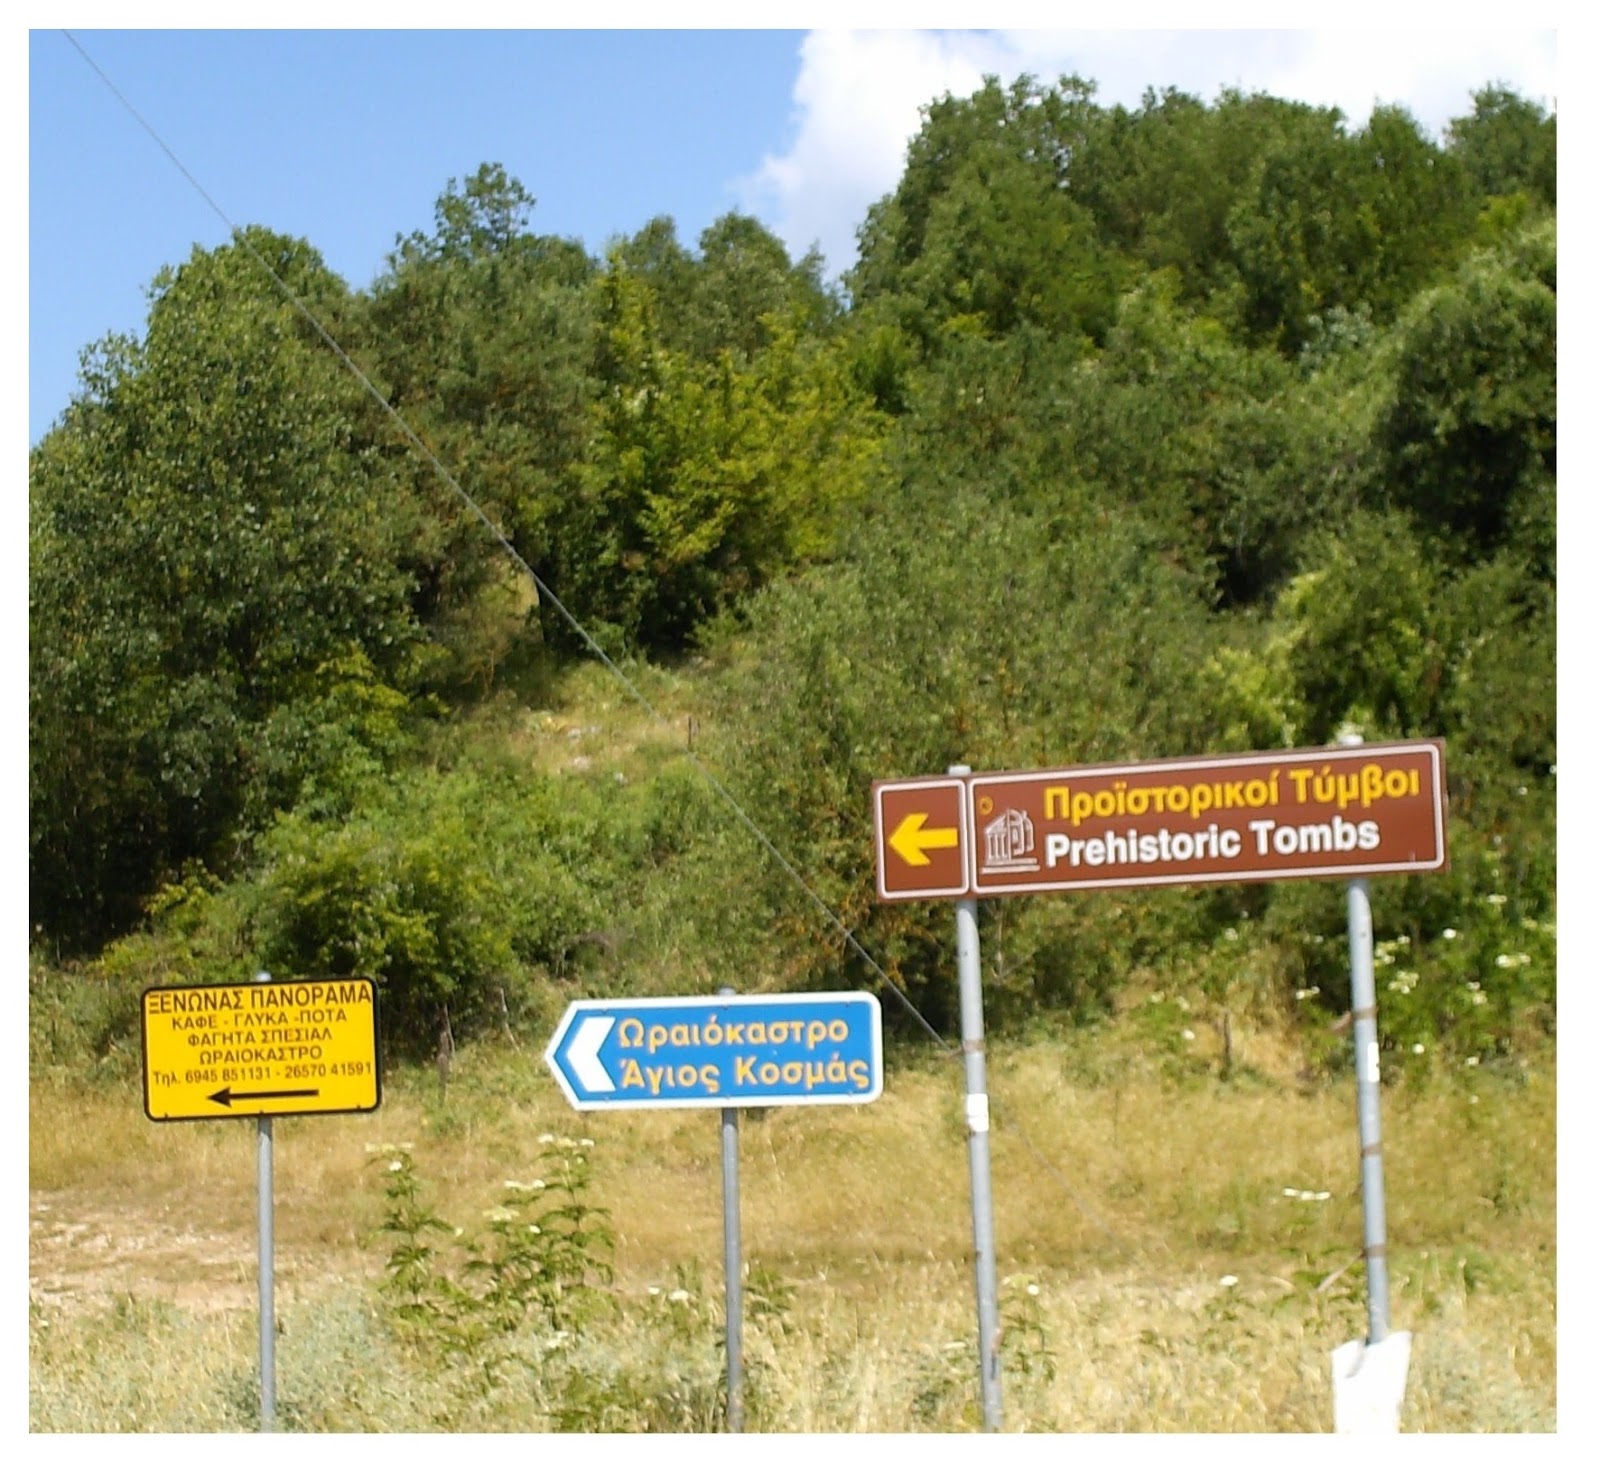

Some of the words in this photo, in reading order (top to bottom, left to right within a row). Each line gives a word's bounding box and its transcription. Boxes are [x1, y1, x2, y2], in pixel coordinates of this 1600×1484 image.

[1044, 768, 1281, 827] Προϊστορικοί
[1287, 763, 1420, 810] Τύμβοι
[1045, 823, 1242, 868] Prehistoric
[1248, 815, 1381, 855] Tombs
[149, 988, 244, 1014] ΞΕΝΩΝΑΣ
[251, 983, 371, 1009] ΠΑΝΟΡΑΜΑ
[172, 1014, 217, 1030] ΚΑΦΕ
[234, 1011, 289, 1028] ΓΛΥΚΑ
[618, 1014, 849, 1054] Ωραιόκαστρο
[188, 1030, 256, 1047] ΦΑΓΗΤΑ
[261, 1027, 333, 1044] ΣΠΕΣΙΑΛ
[199, 1045, 322, 1065] ΩΡΑΙΟΚΑΣΤΡΟ
[153, 1070, 181, 1088] Τηλ.
[185, 1068, 218, 1084] 6945
[222, 1066, 271, 1082] 851131
[285, 1063, 326, 1079] 26570
[331, 1061, 372, 1077] 41591
[620, 1058, 720, 1095] Άγιος
[734, 1052, 870, 1090] Κοσμάς
